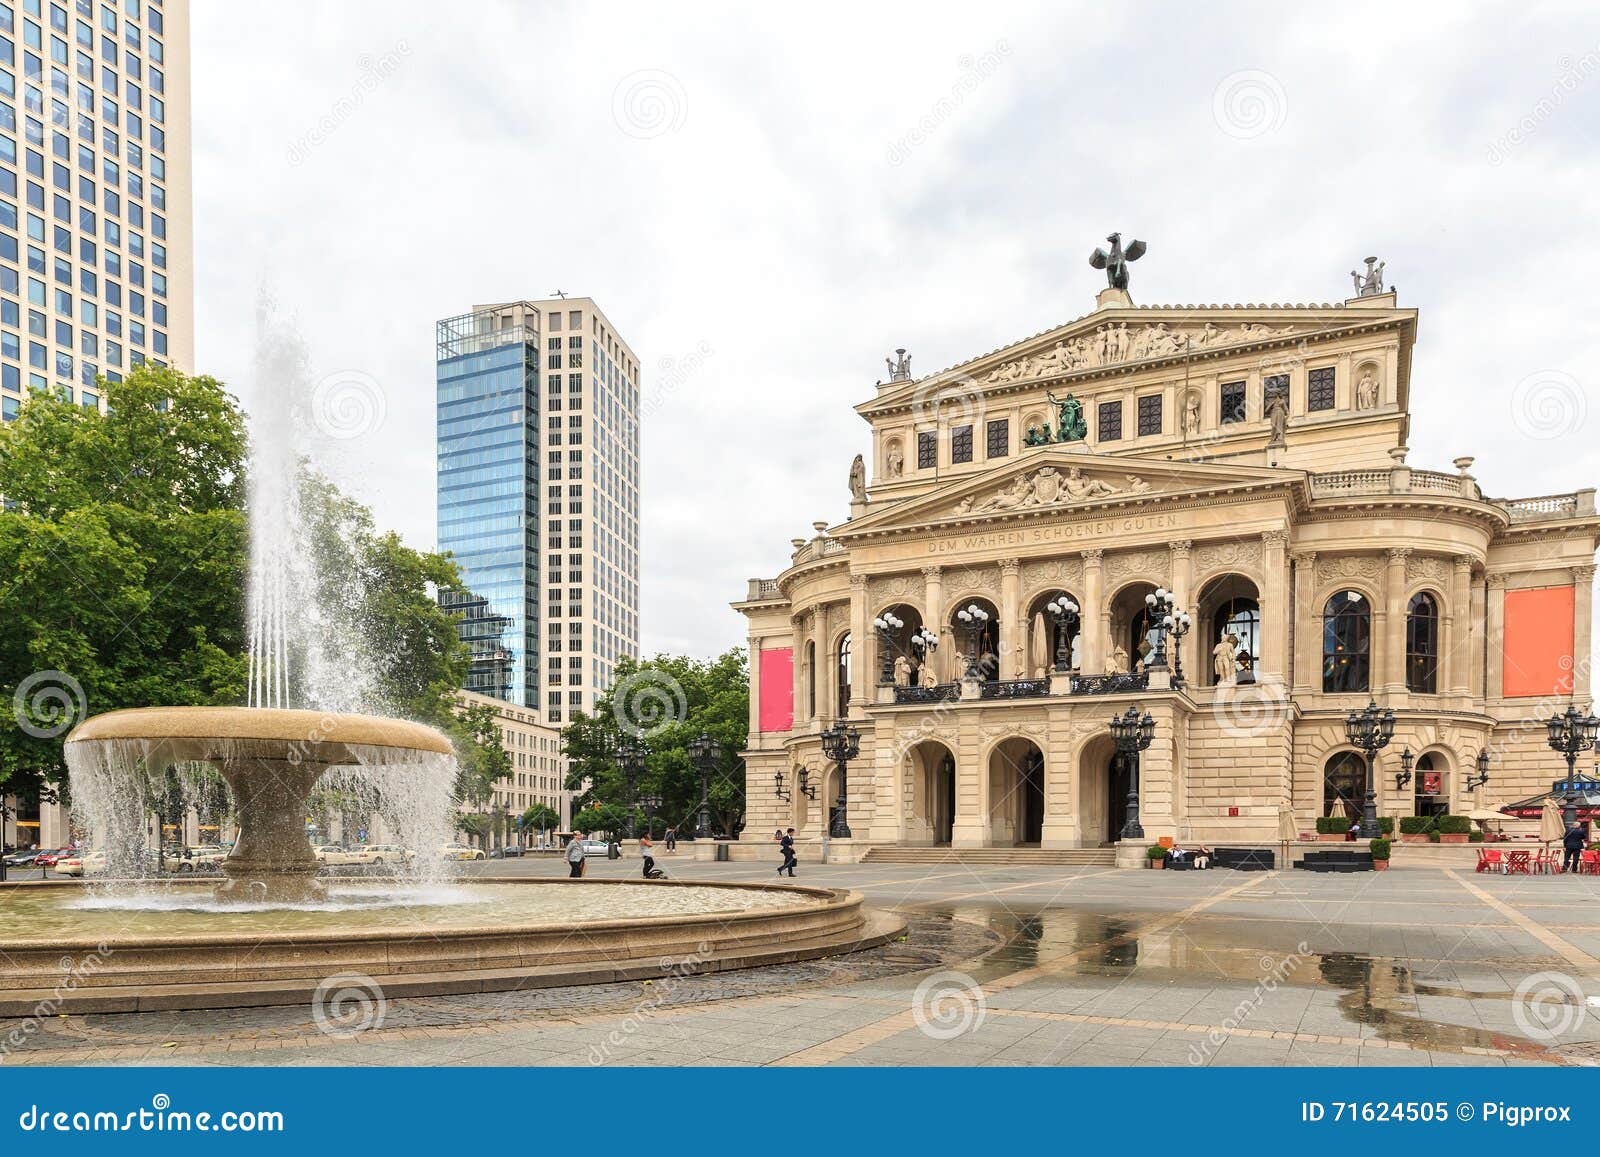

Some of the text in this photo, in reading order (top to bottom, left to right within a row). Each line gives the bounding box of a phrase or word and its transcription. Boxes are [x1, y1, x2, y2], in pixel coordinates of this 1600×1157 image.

[928, 541, 957, 553] DEM
[964, 532, 1026, 549] WAHREN
[1033, 521, 1115, 542] SCHOENEN
